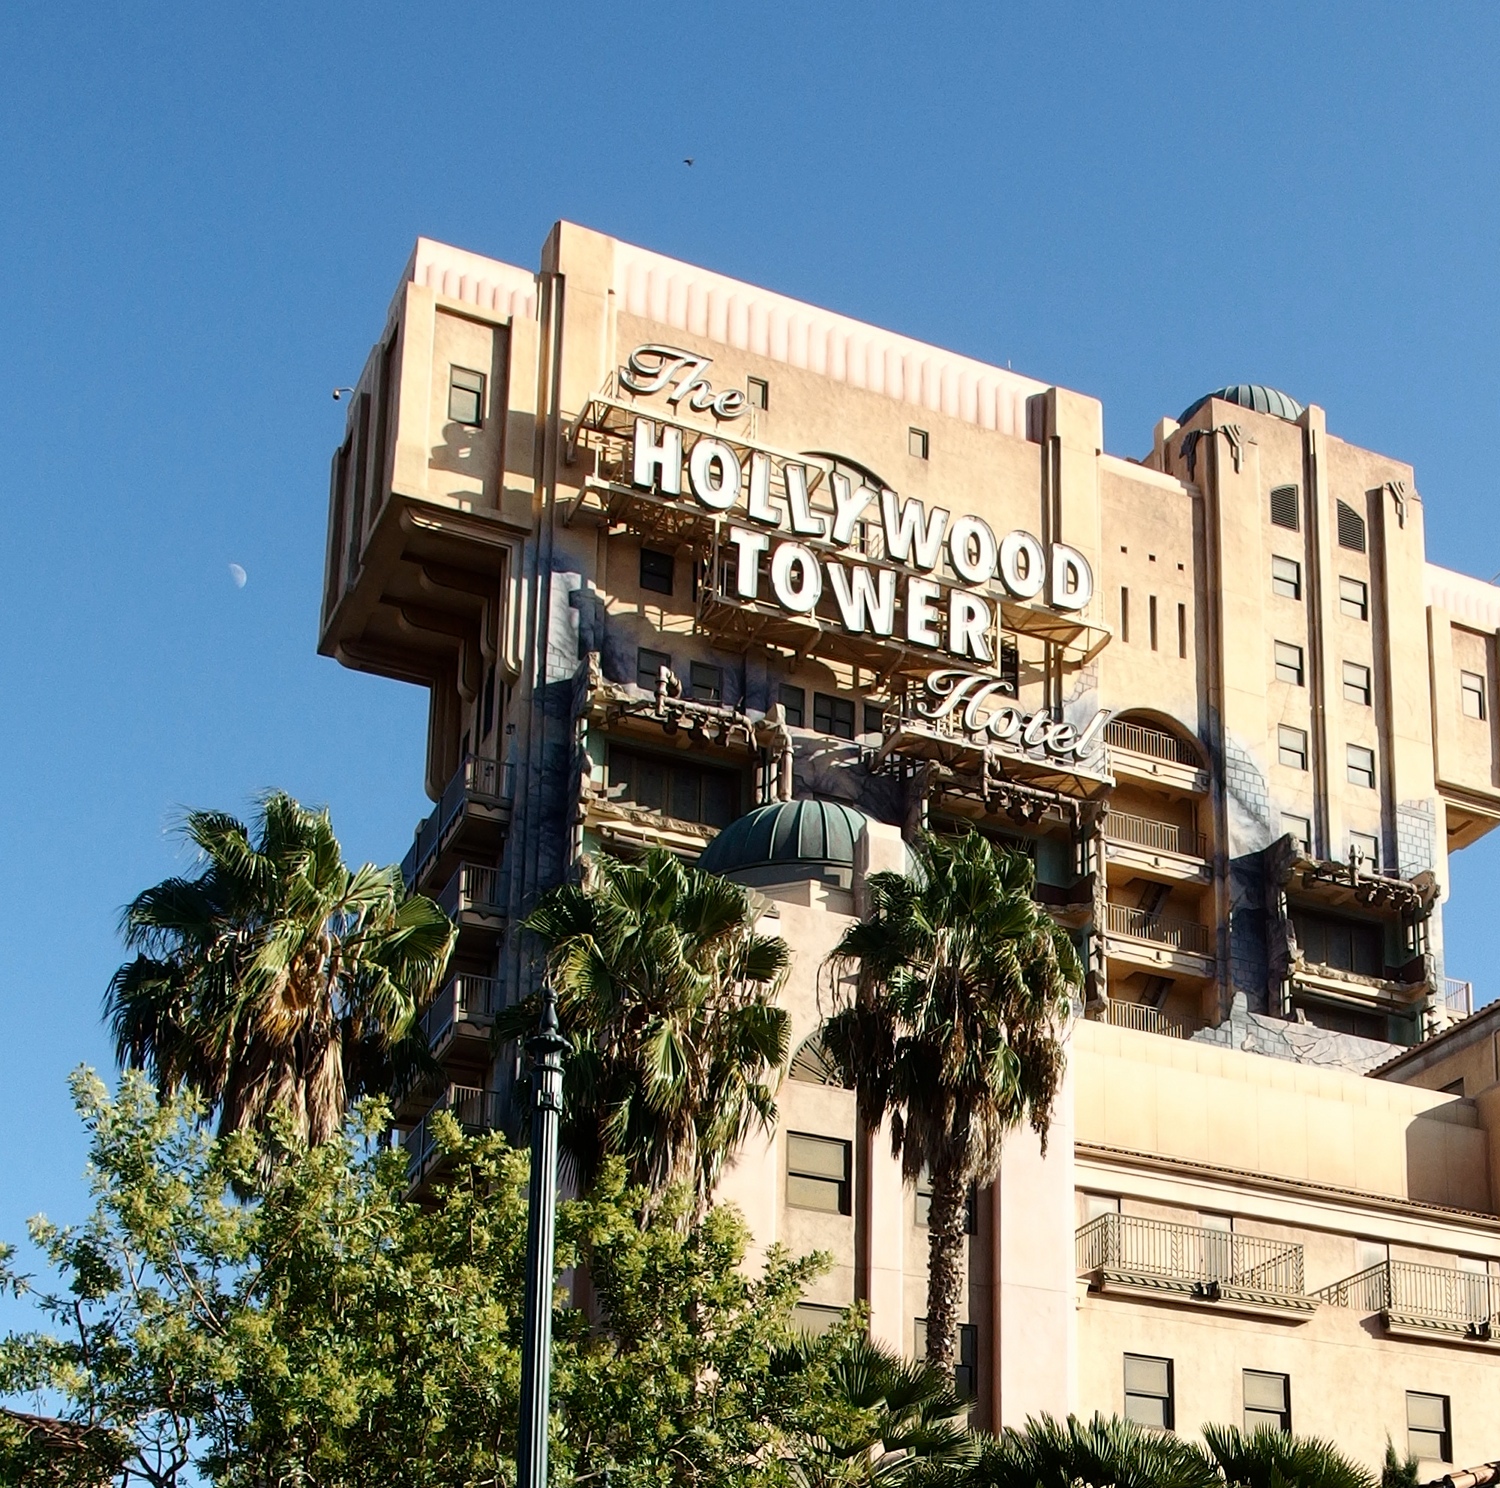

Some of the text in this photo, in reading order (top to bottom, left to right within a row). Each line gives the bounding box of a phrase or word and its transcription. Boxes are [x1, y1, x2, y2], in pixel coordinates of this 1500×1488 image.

[619, 344, 751, 419] The
[632, 418, 1095, 611] HOLLYWOOD
[729, 526, 996, 663] TOWER
[916, 669, 1112, 762] Hotel
